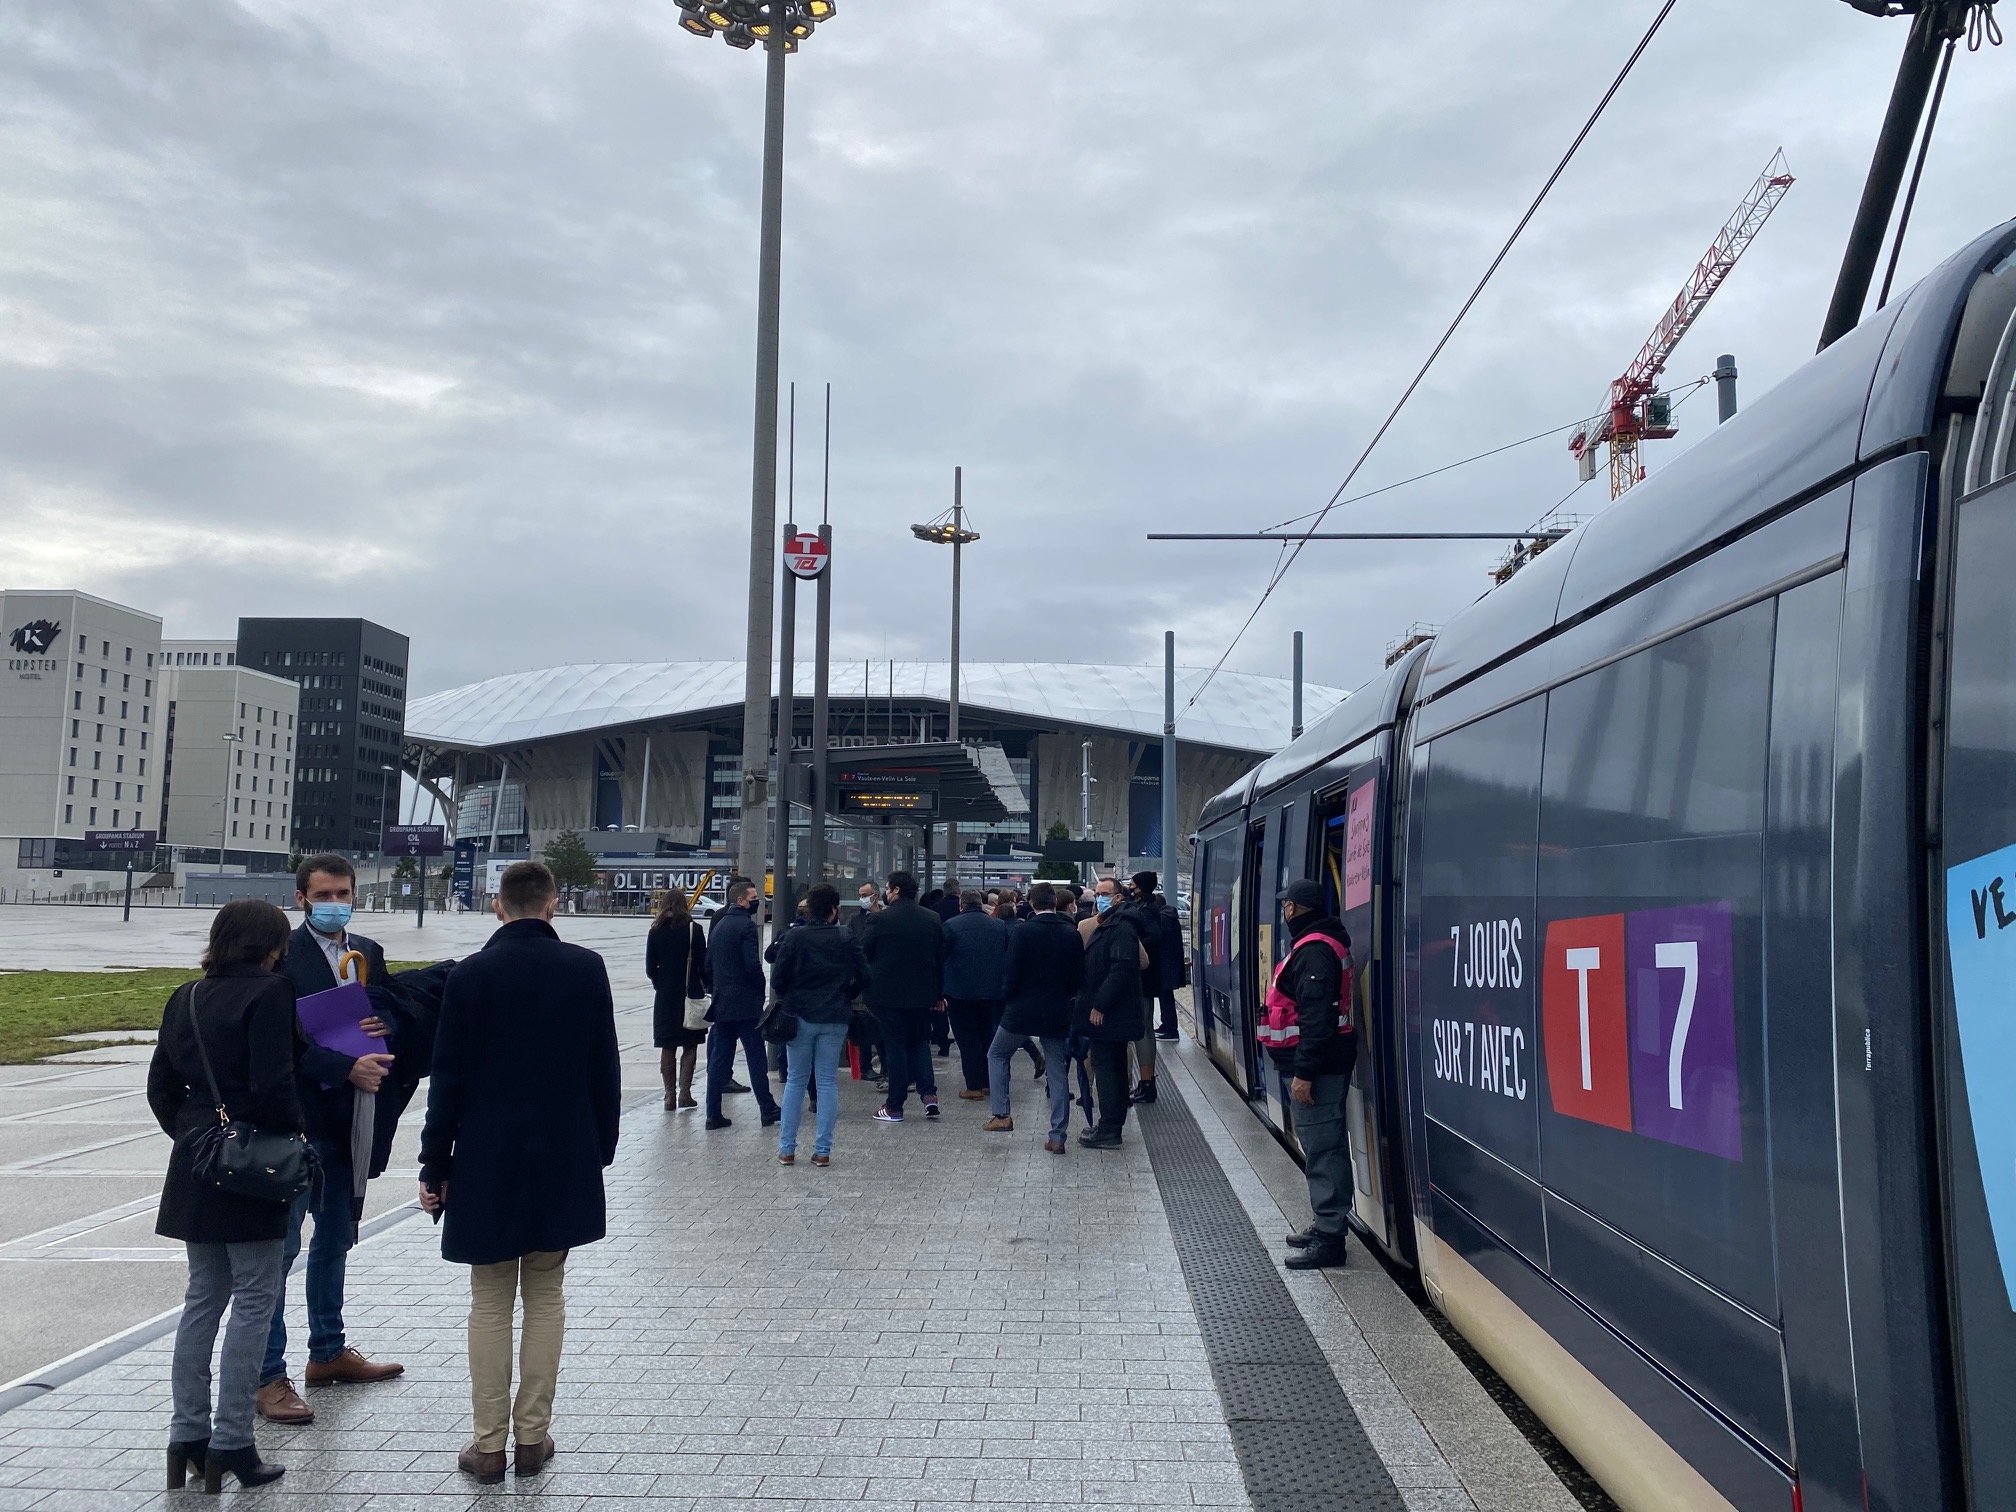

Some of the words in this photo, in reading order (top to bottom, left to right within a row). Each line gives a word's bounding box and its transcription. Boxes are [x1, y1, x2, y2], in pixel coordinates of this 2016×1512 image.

[795, 537, 819, 554] T
[794, 556, 818, 570] TCL
[9, 659, 56, 671] KOPSTER
[614, 872, 637, 889] OL
[642, 872, 663, 889] LE
[1451, 925, 1461, 988] 7
[1464, 917, 1523, 989] JOURS
[1566, 946, 1601, 1092] T
[1655, 941, 1699, 1111] 7
[1433, 1018, 1464, 1085] SUR
[1464, 1022, 1475, 1087] 7
[1480, 1023, 1527, 1101] AVEC
[1864, 1028, 1873, 1071] Terrapublica
